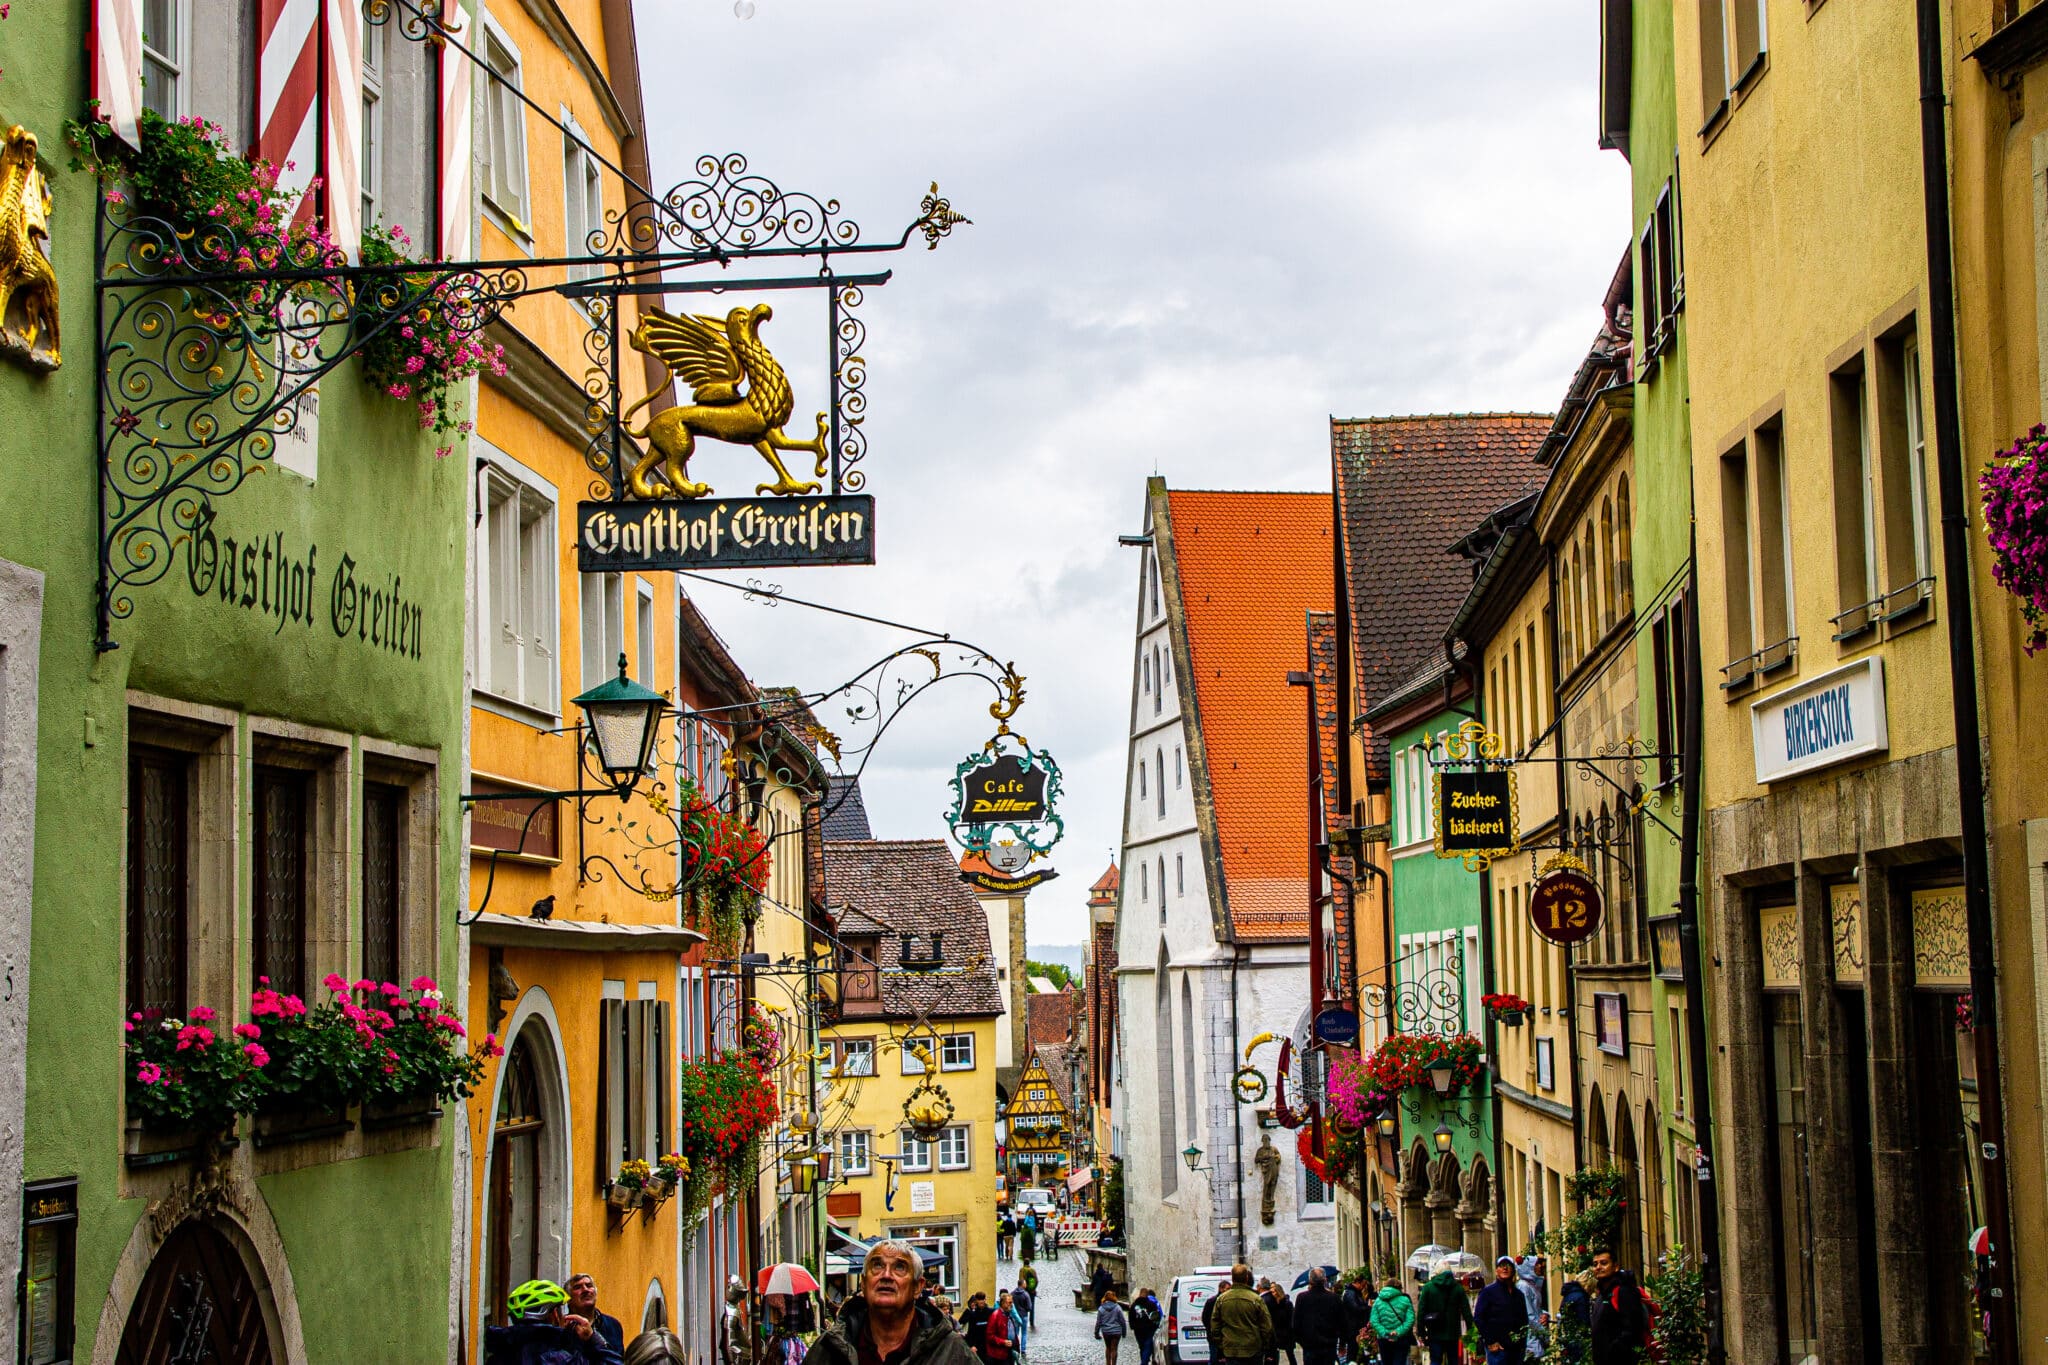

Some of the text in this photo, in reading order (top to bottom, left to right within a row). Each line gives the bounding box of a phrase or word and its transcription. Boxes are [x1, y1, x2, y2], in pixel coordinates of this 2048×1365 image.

[730, 501, 864, 552] Greifen
[187, 501, 422, 662] Gasthof Greifen
[1783, 683, 1854, 761] BIRKENSTOCK
[984, 780, 1024, 794] Cafe
[972, 798, 1038, 813] Diller
[1450, 790, 1501, 810] Zucker-
[1449, 816, 1504, 837] bäckerei
[1546, 899, 1587, 929] 12
